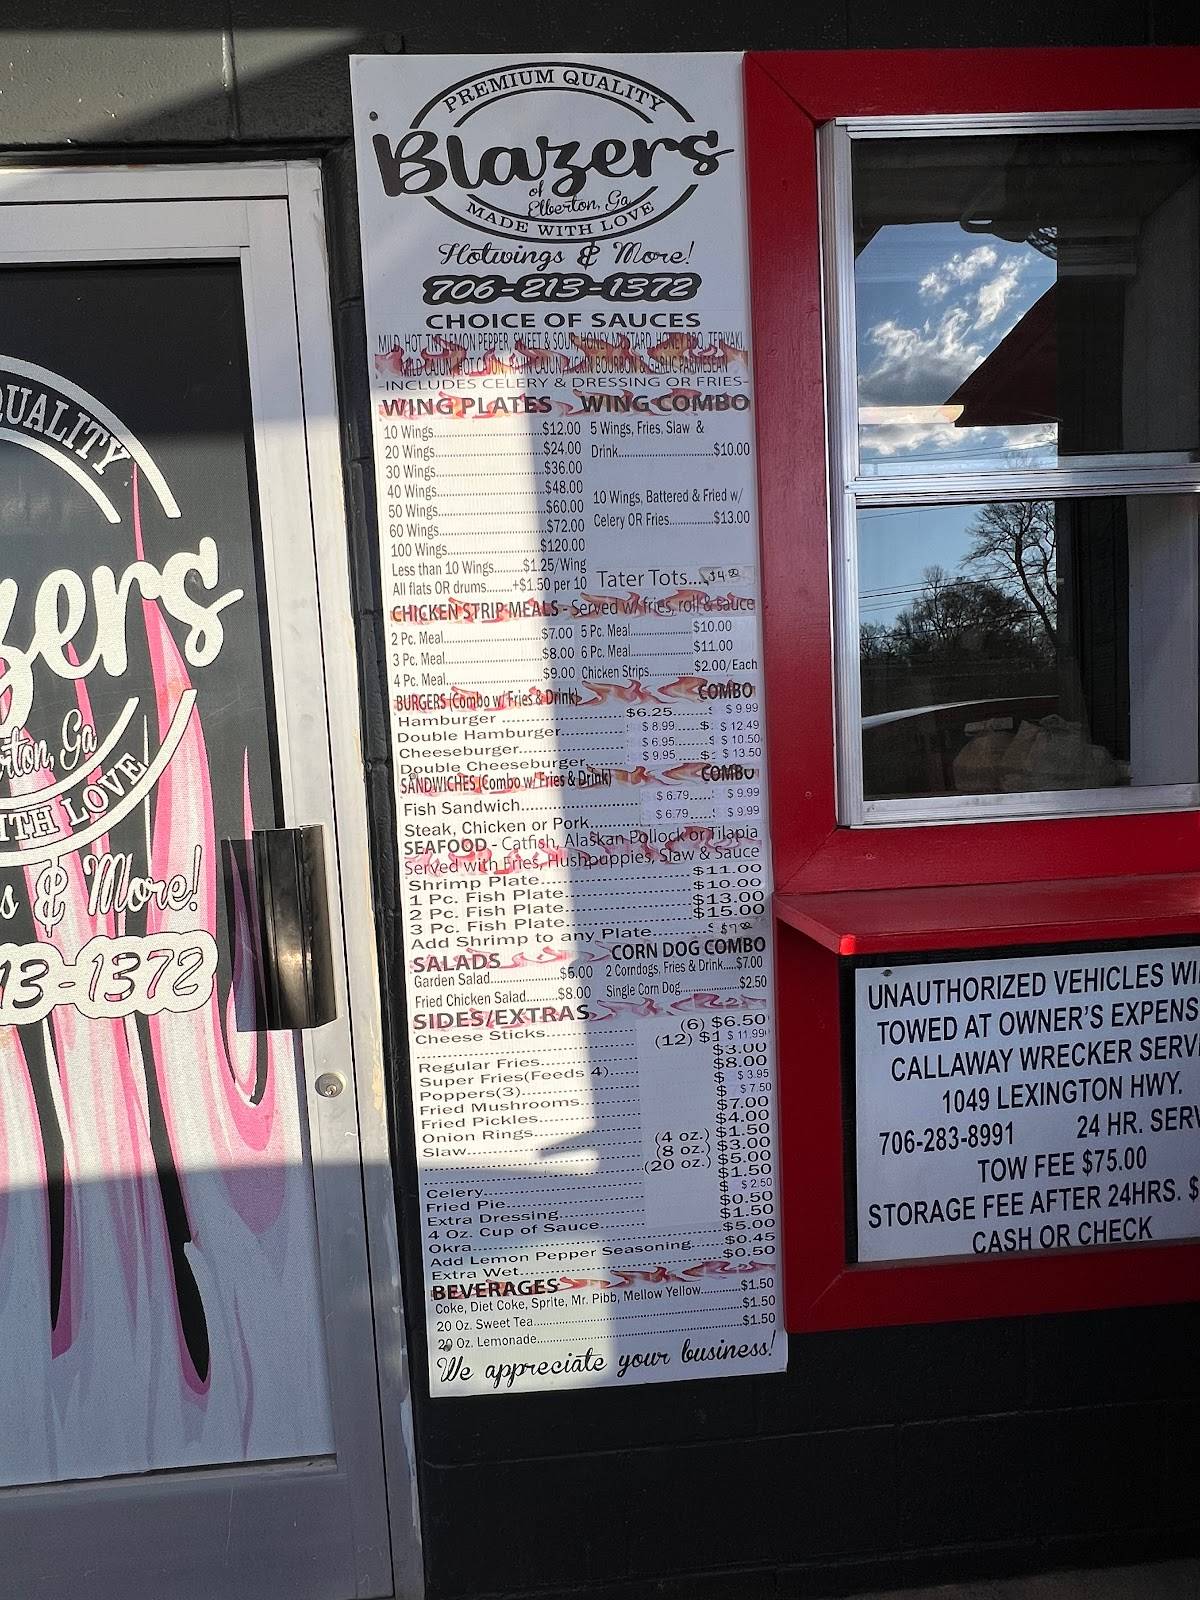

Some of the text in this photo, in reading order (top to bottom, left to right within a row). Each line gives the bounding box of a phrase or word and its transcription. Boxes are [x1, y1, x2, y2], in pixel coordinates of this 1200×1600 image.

[442, 69, 666, 114] PREMIUM QUALITY
[372, 130, 734, 197] Blazers
[529, 180, 544, 197] of
[465, 200, 655, 237] MADE WITH LOVE
[438, 241, 566, 271] Hotwings
[613, 240, 694, 265] More!
[431, 276, 694, 302] 706-213-1372
[426, 311, 701, 329] CHOICE OF SAUCES
[482, 376, 548, 389] CELERY
[554, 376, 566, 388] &
[572, 376, 661, 388] DRESSING
[666, 376, 691, 387] OR
[382, 395, 553, 417] WING PLATES
[580, 393, 750, 413] WING COMBO
[0, 384, 132, 475] UALITY
[384, 425, 398, 439] 10
[542, 421, 581, 436] $12.00
[590, 421, 597, 435] 5
[600, 421, 634, 438] Wings,
[666, 420, 690, 434] Slaw
[696, 420, 705, 434] &
[713, 441, 750, 457] $10.00
[593, 490, 607, 504] 10
[646, 488, 689, 504] Battered
[691, 488, 700, 502] &
[703, 487, 727, 502] Fried
[593, 513, 625, 530] Celery
[628, 512, 643, 527] OR
[713, 510, 750, 525] $13.00
[392, 563, 416, 577] Less
[418, 562, 442, 576] than
[445, 561, 459, 575] 10
[596, 570, 645, 588] Tater
[392, 602, 459, 622] CHICKEN
[462, 601, 504, 620] STRIP
[508, 599, 559, 618] MEALS
[571, 599, 618, 616] Served
[678, 595, 701, 613] roll
[716, 598, 756, 612] sauce
[582, 665, 620, 680] Chicken
[694, 658, 758, 673] $2.00/Each
[396, 693, 447, 712] BURGERS
[449, 691, 491, 712] (Combo
[508, 690, 533, 707] Fries
[697, 682, 753, 700] COMBO
[61, 752, 149, 827] LOVE
[401, 773, 477, 794] SANDWICHES
[539, 771, 565, 788] Fries
[567, 770, 576, 786] &
[404, 838, 487, 855] SEAFOOD
[502, 835, 560, 851] Catfish,
[564, 831, 624, 847] Alaskan
[629, 827, 685, 844] Pollock
[690, 830, 705, 841] or
[707, 825, 759, 842] Tilapia
[404, 859, 459, 876] Served
[464, 857, 498, 874] with
[504, 855, 543, 872] Fries,
[659, 848, 695, 863] Slaw
[700, 847, 711, 860] &
[715, 846, 760, 860] Sauce
[83, 845, 203, 916] More!
[611, 936, 767, 960] CORN DOG COMBO
[413, 953, 501, 973] SALADS
[415, 995, 443, 1009] Fried
[446, 991, 491, 1008] Chicken
[557, 985, 592, 1001] $8.00
[868, 960, 1200, 1011] UNAUTHORIZED VEHICLES WI
[412, 1004, 590, 1031] SIDES/EXTRAS
[877, 1015, 957, 1046] TOWED
[964, 1012, 992, 1039] AT
[891, 1048, 1014, 1083] CALLAWAY
[1020, 1039, 1132, 1072] WRECKER
[942, 1070, 1183, 1115] 1049 LEXINGTON HWY.
[879, 1121, 1014, 1156] 706-283-8991
[1077, 1113, 1100, 1139] 24
[1107, 1110, 1143, 1137] HR.
[977, 1145, 1147, 1183] TOW FEE $75.00
[868, 1197, 976, 1230] STORAGE
[983, 1192, 1024, 1219] FEE
[1030, 1185, 1101, 1215] AFTER
[1107, 1178, 1181, 1208] 24HRS.
[972, 1215, 1153, 1255] CASH OR CHECK
[432, 1278, 559, 1301] BEVERAGES
[436, 1321, 452, 1332] 20
[455, 1320, 473, 1331] Oz.
[475, 1317, 511, 1330] Sweet
[742, 1294, 776, 1310] $1.50
[436, 1329, 777, 1389] We appreciate your business!
